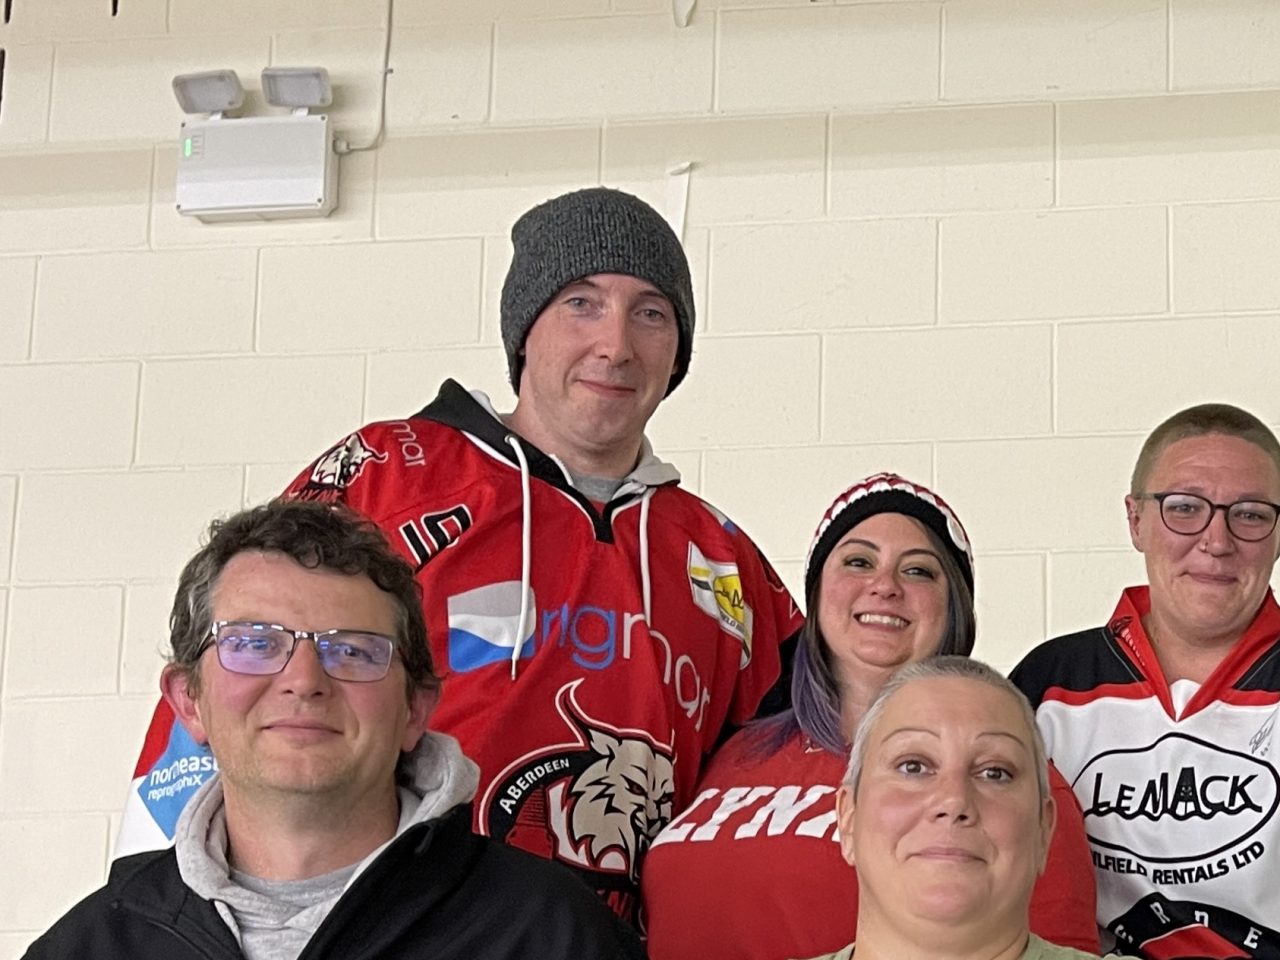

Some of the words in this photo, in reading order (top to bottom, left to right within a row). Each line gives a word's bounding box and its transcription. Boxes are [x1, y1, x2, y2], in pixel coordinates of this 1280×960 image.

[500, 757, 570, 815] ABERDEEN
[1152, 859, 1230, 885] RENTALS
[1232, 841, 1265, 870] LTD
